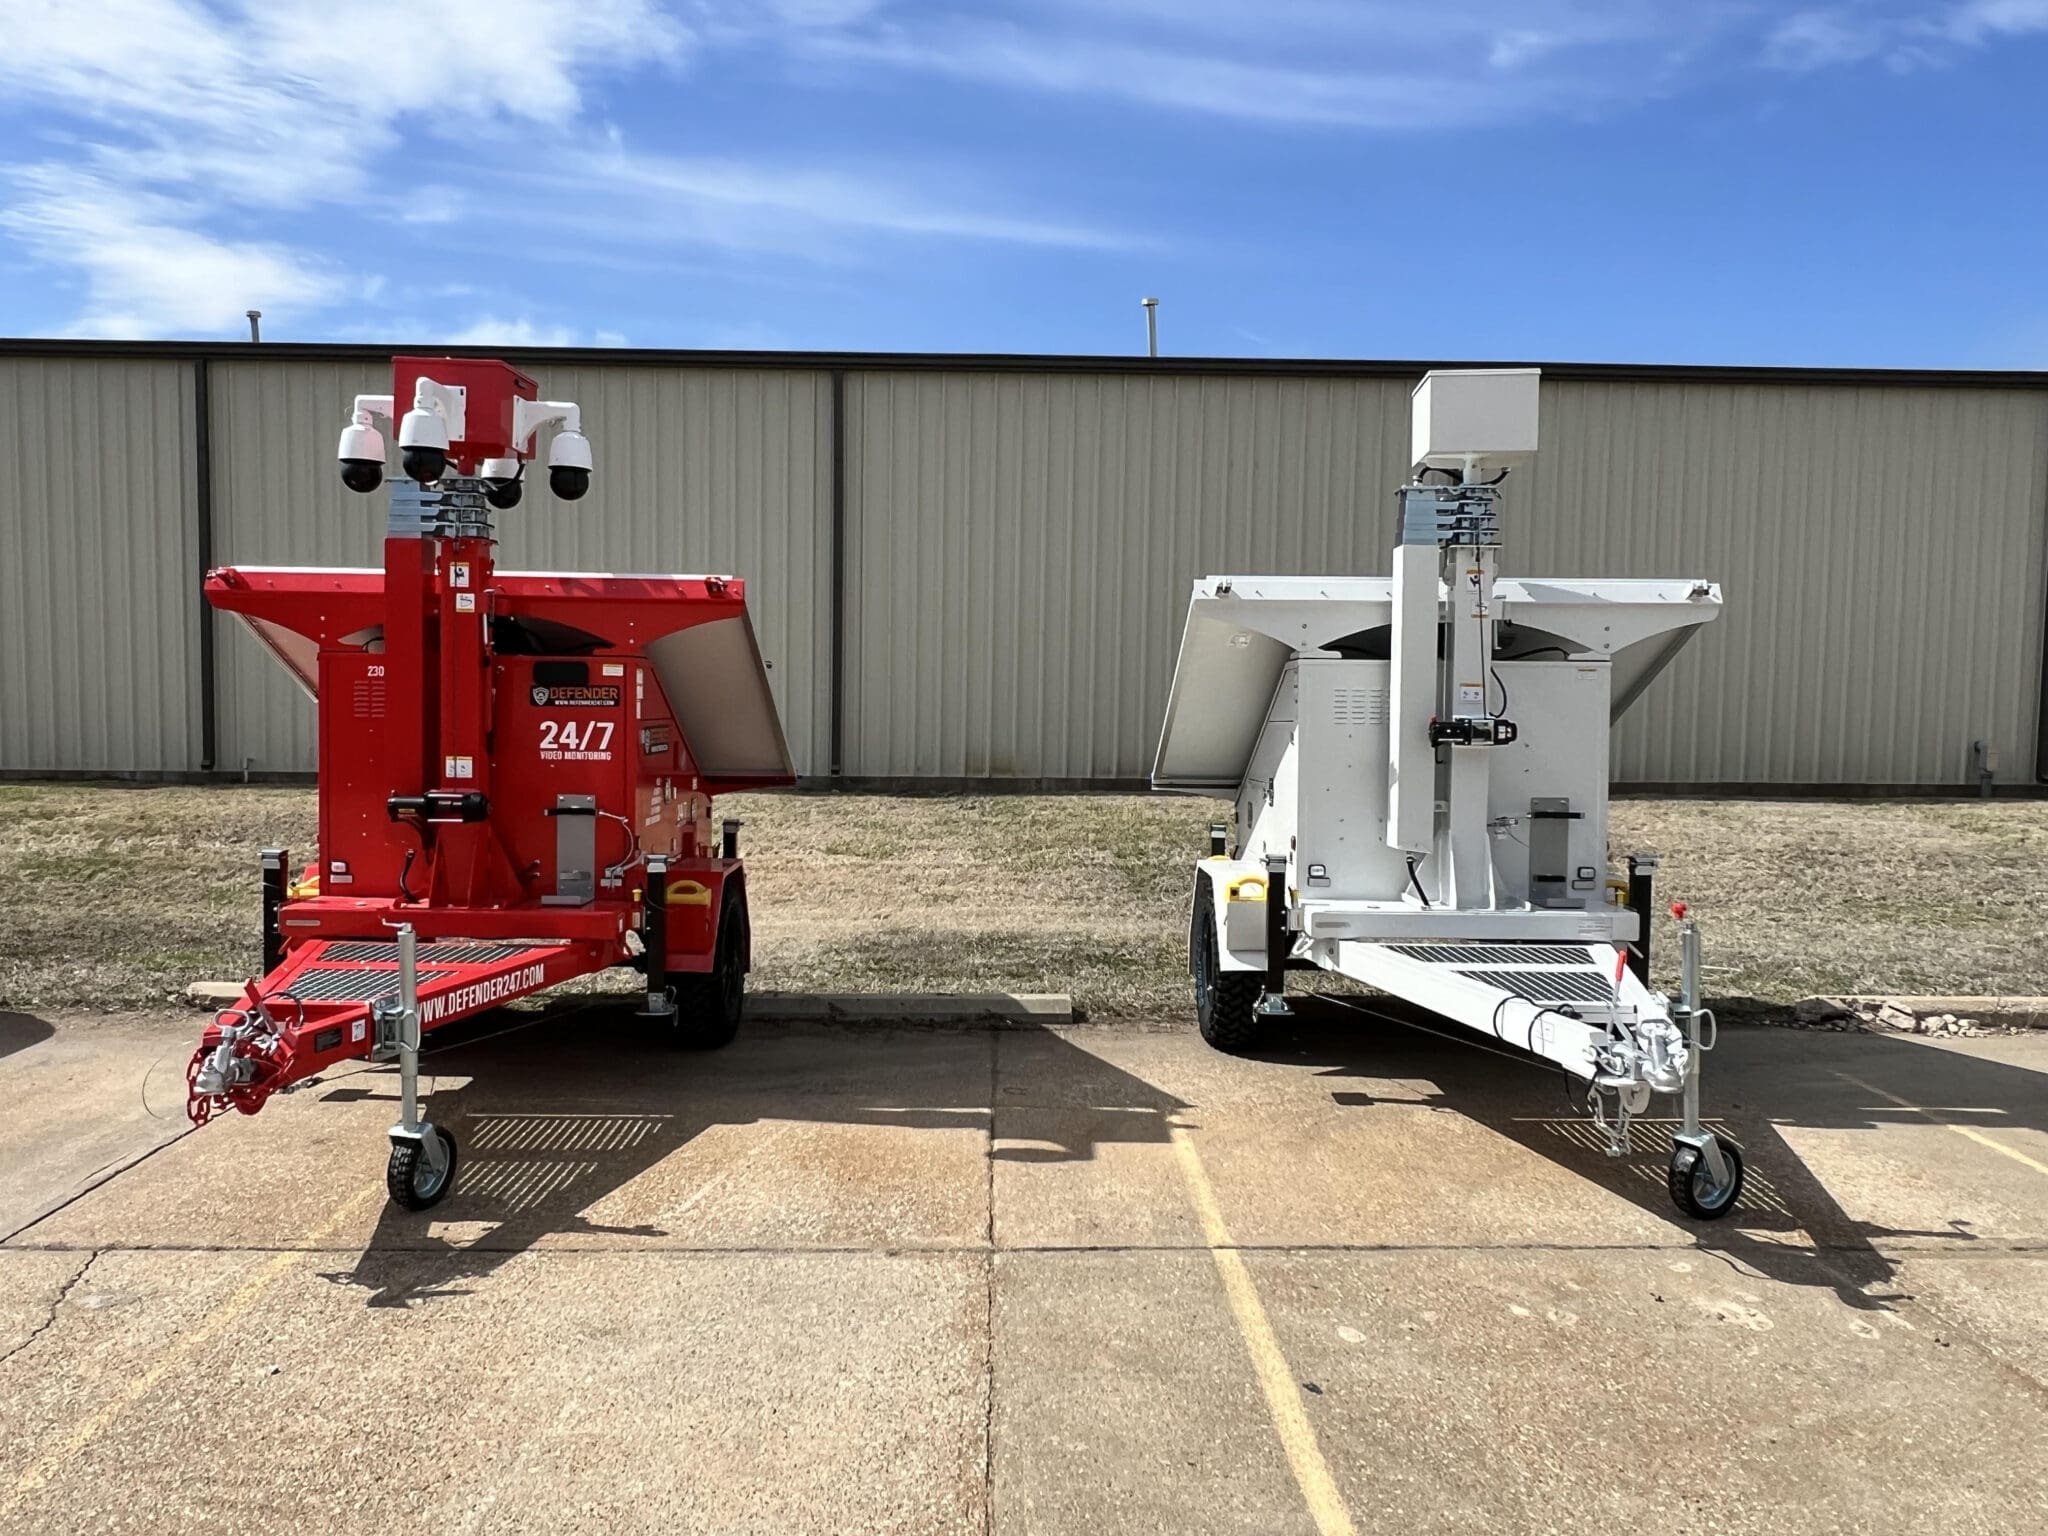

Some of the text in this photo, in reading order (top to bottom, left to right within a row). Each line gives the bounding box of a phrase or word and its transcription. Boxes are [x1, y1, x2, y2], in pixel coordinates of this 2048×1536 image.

[550, 687, 618, 699] DEFENDER
[539, 720, 615, 751] 24/7
[540, 751, 612, 761] VIDEO MONITORING
